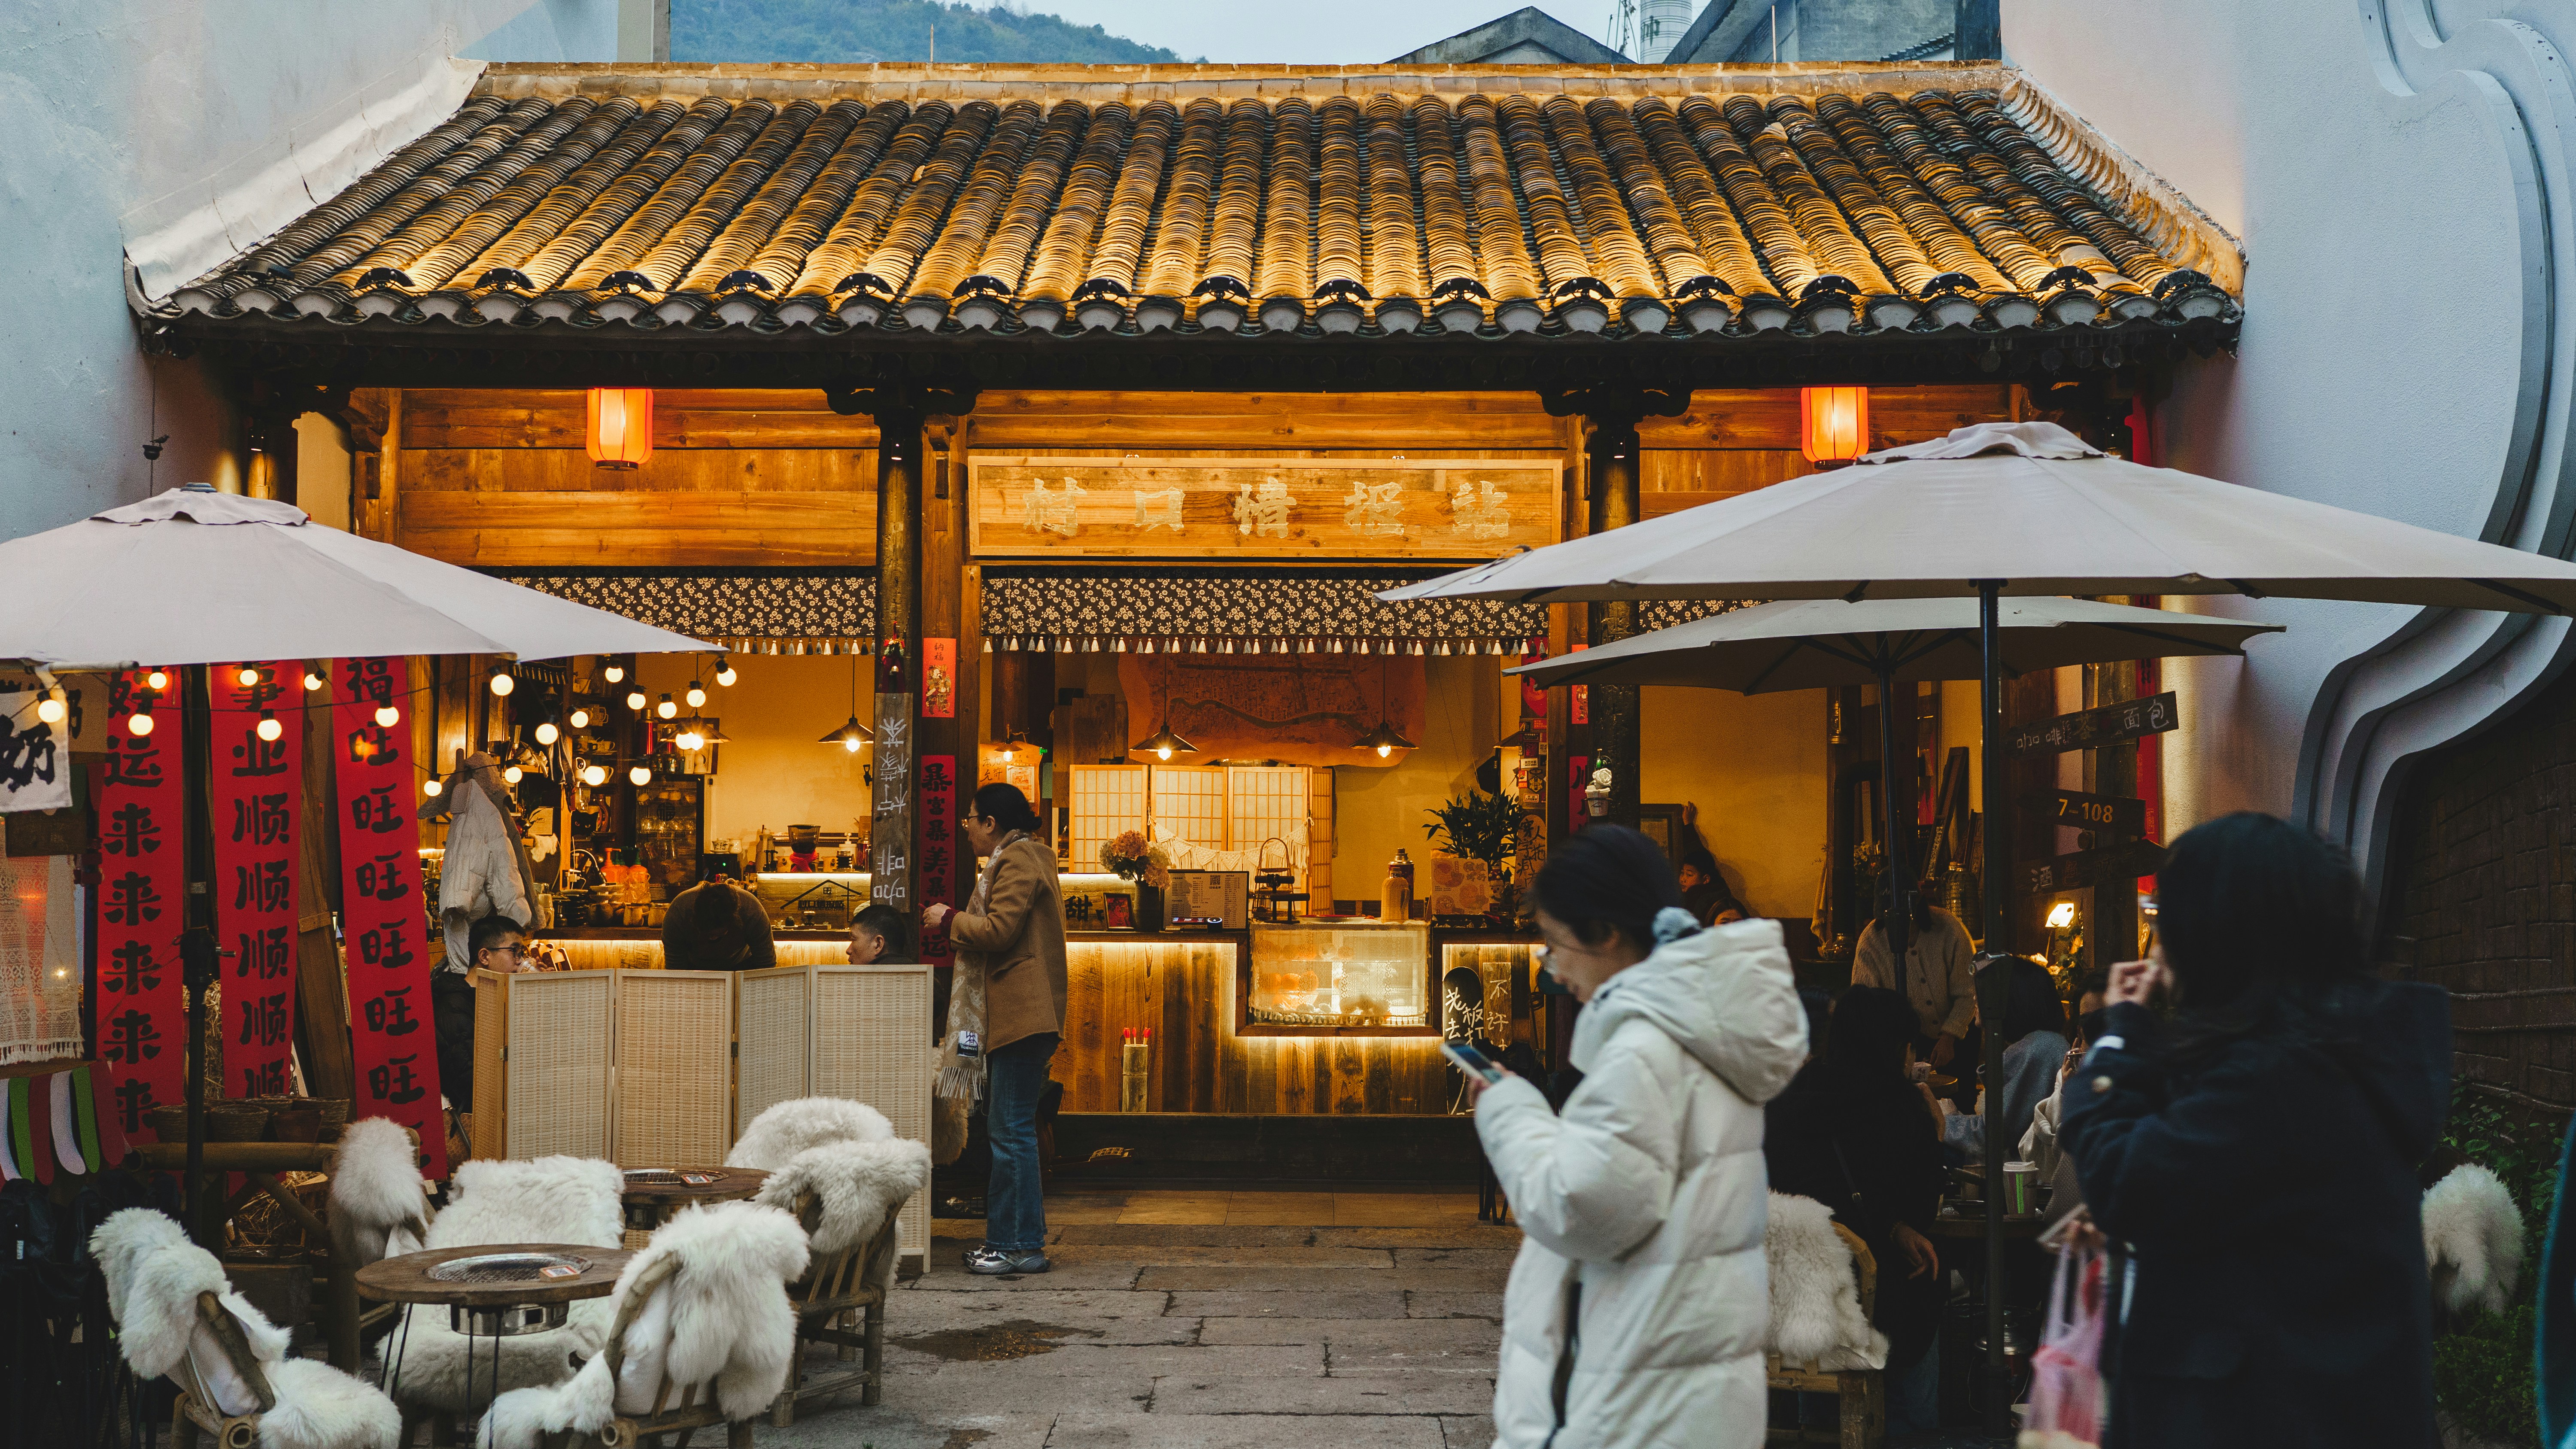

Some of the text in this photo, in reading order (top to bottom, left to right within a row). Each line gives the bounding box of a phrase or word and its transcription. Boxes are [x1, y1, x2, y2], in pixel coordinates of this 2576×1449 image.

[1023, 476, 1510, 539] 村口情报站
[2017, 731, 2062, 752] 咖啡
[2123, 699, 2169, 729] 面包
[873, 717, 909, 905] 咖啡 柠檬茶
[921, 762, 952, 957] 暴富暴美暴运
[2058, 799, 2114, 823] 7-108
[346, 658, 431, 1169] 福旺旺旺旺旺旺
